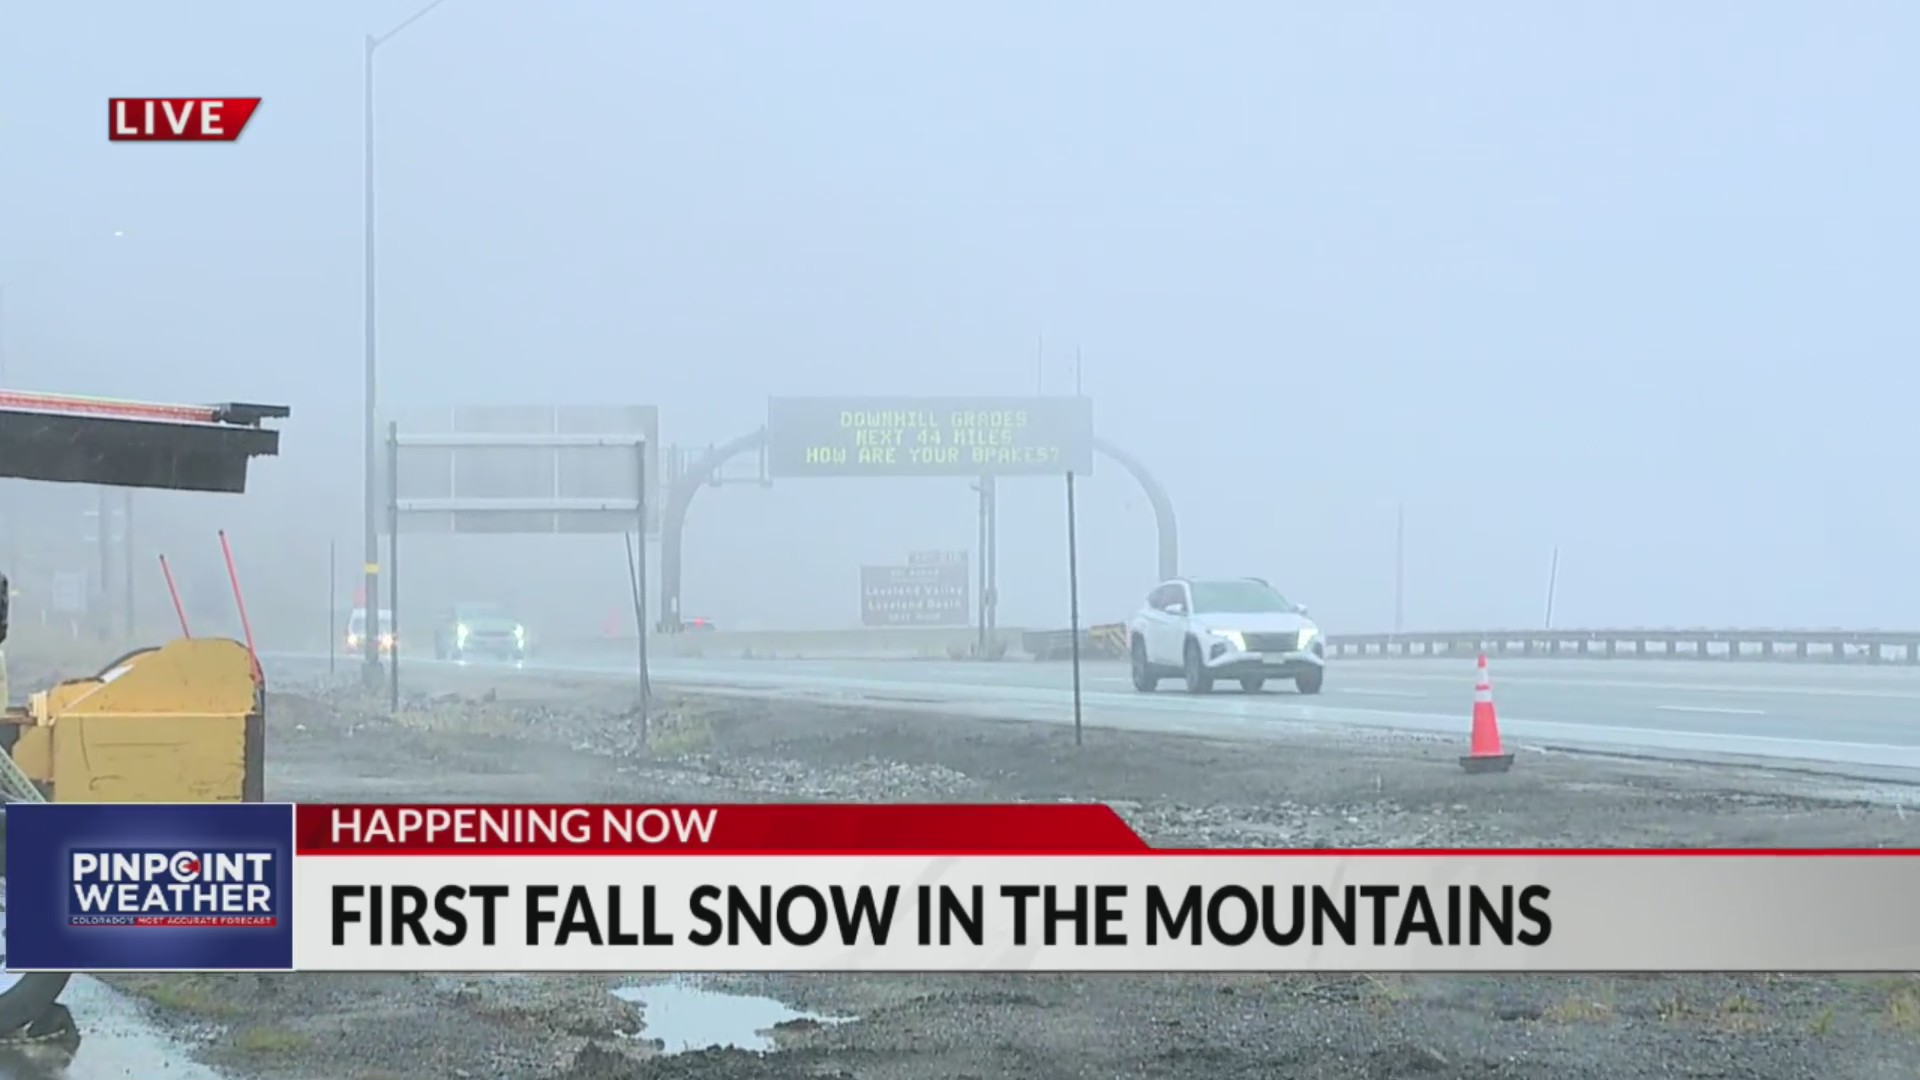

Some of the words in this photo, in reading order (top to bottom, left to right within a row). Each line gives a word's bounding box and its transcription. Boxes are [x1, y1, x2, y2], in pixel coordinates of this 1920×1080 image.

[840, 411, 938, 428] DOWNHILL
[951, 411, 1029, 428] GRADES
[856, 429, 904, 446] NEXT
[917, 429, 942, 445] 44
[954, 429, 1013, 446] MILES
[806, 447, 847, 464] HOW
[858, 447, 897, 464] ARE
[909, 447, 960, 464] YOUR
